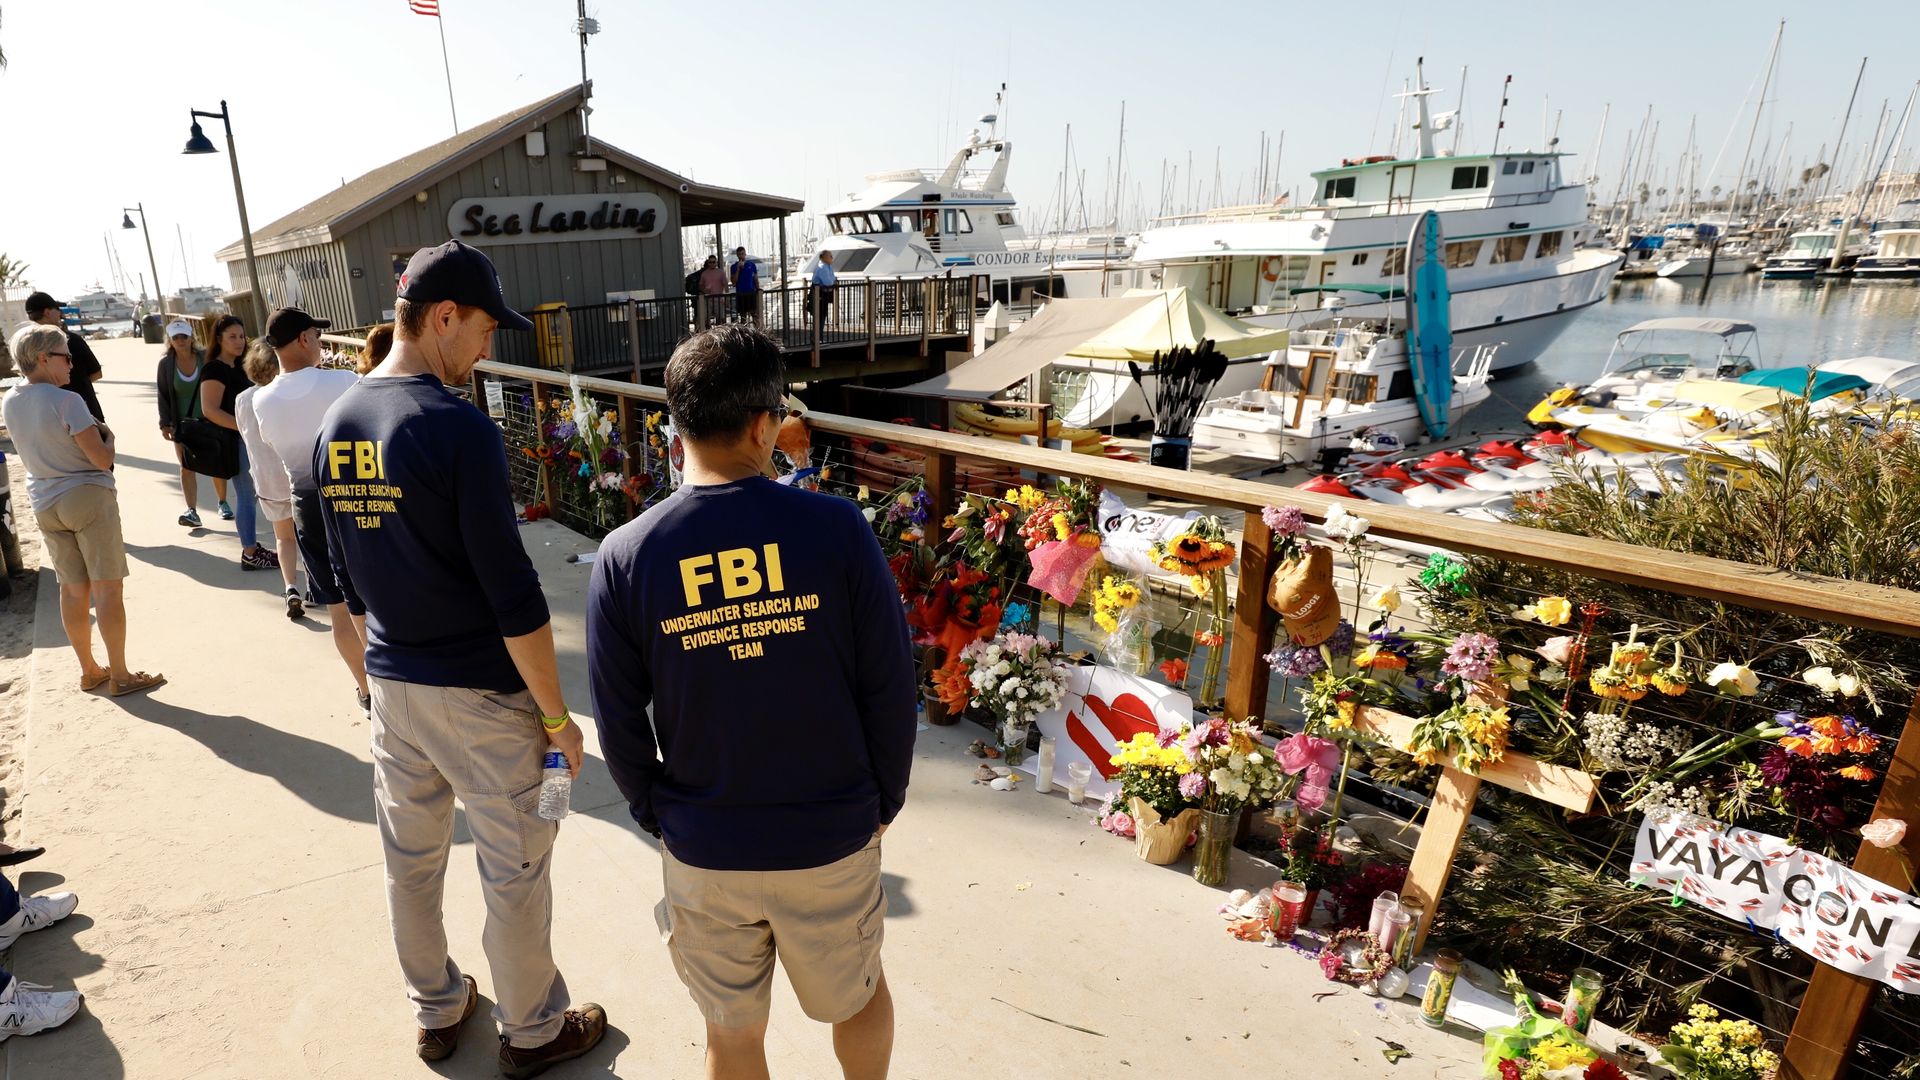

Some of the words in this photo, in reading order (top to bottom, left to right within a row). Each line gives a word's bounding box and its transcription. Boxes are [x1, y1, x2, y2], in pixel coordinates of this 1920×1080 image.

[460, 204, 523, 236] Sea
[529, 202, 656, 234] Landing
[976, 252, 1030, 266] CONDOR
[1035, 252, 1077, 265] Express
[328, 440, 385, 480] FBI
[332, 500, 365, 513] VIDENCE
[366, 500, 398, 513] RESPONS
[355, 515, 381, 529] TEAM
[678, 542, 785, 608] FBI
[660, 604, 741, 635] UNDERWATER
[742, 597, 791, 619] SEARCH
[794, 593, 820, 612] AND
[1295, 593, 1320, 616] LODGE
[681, 625, 741, 651] EVIDENCE
[741, 616, 806, 640] RESPONSE
[728, 641, 764, 661] TEAM
[1648, 828, 1769, 895] VAYA
[1783, 874, 1893, 948] CON
